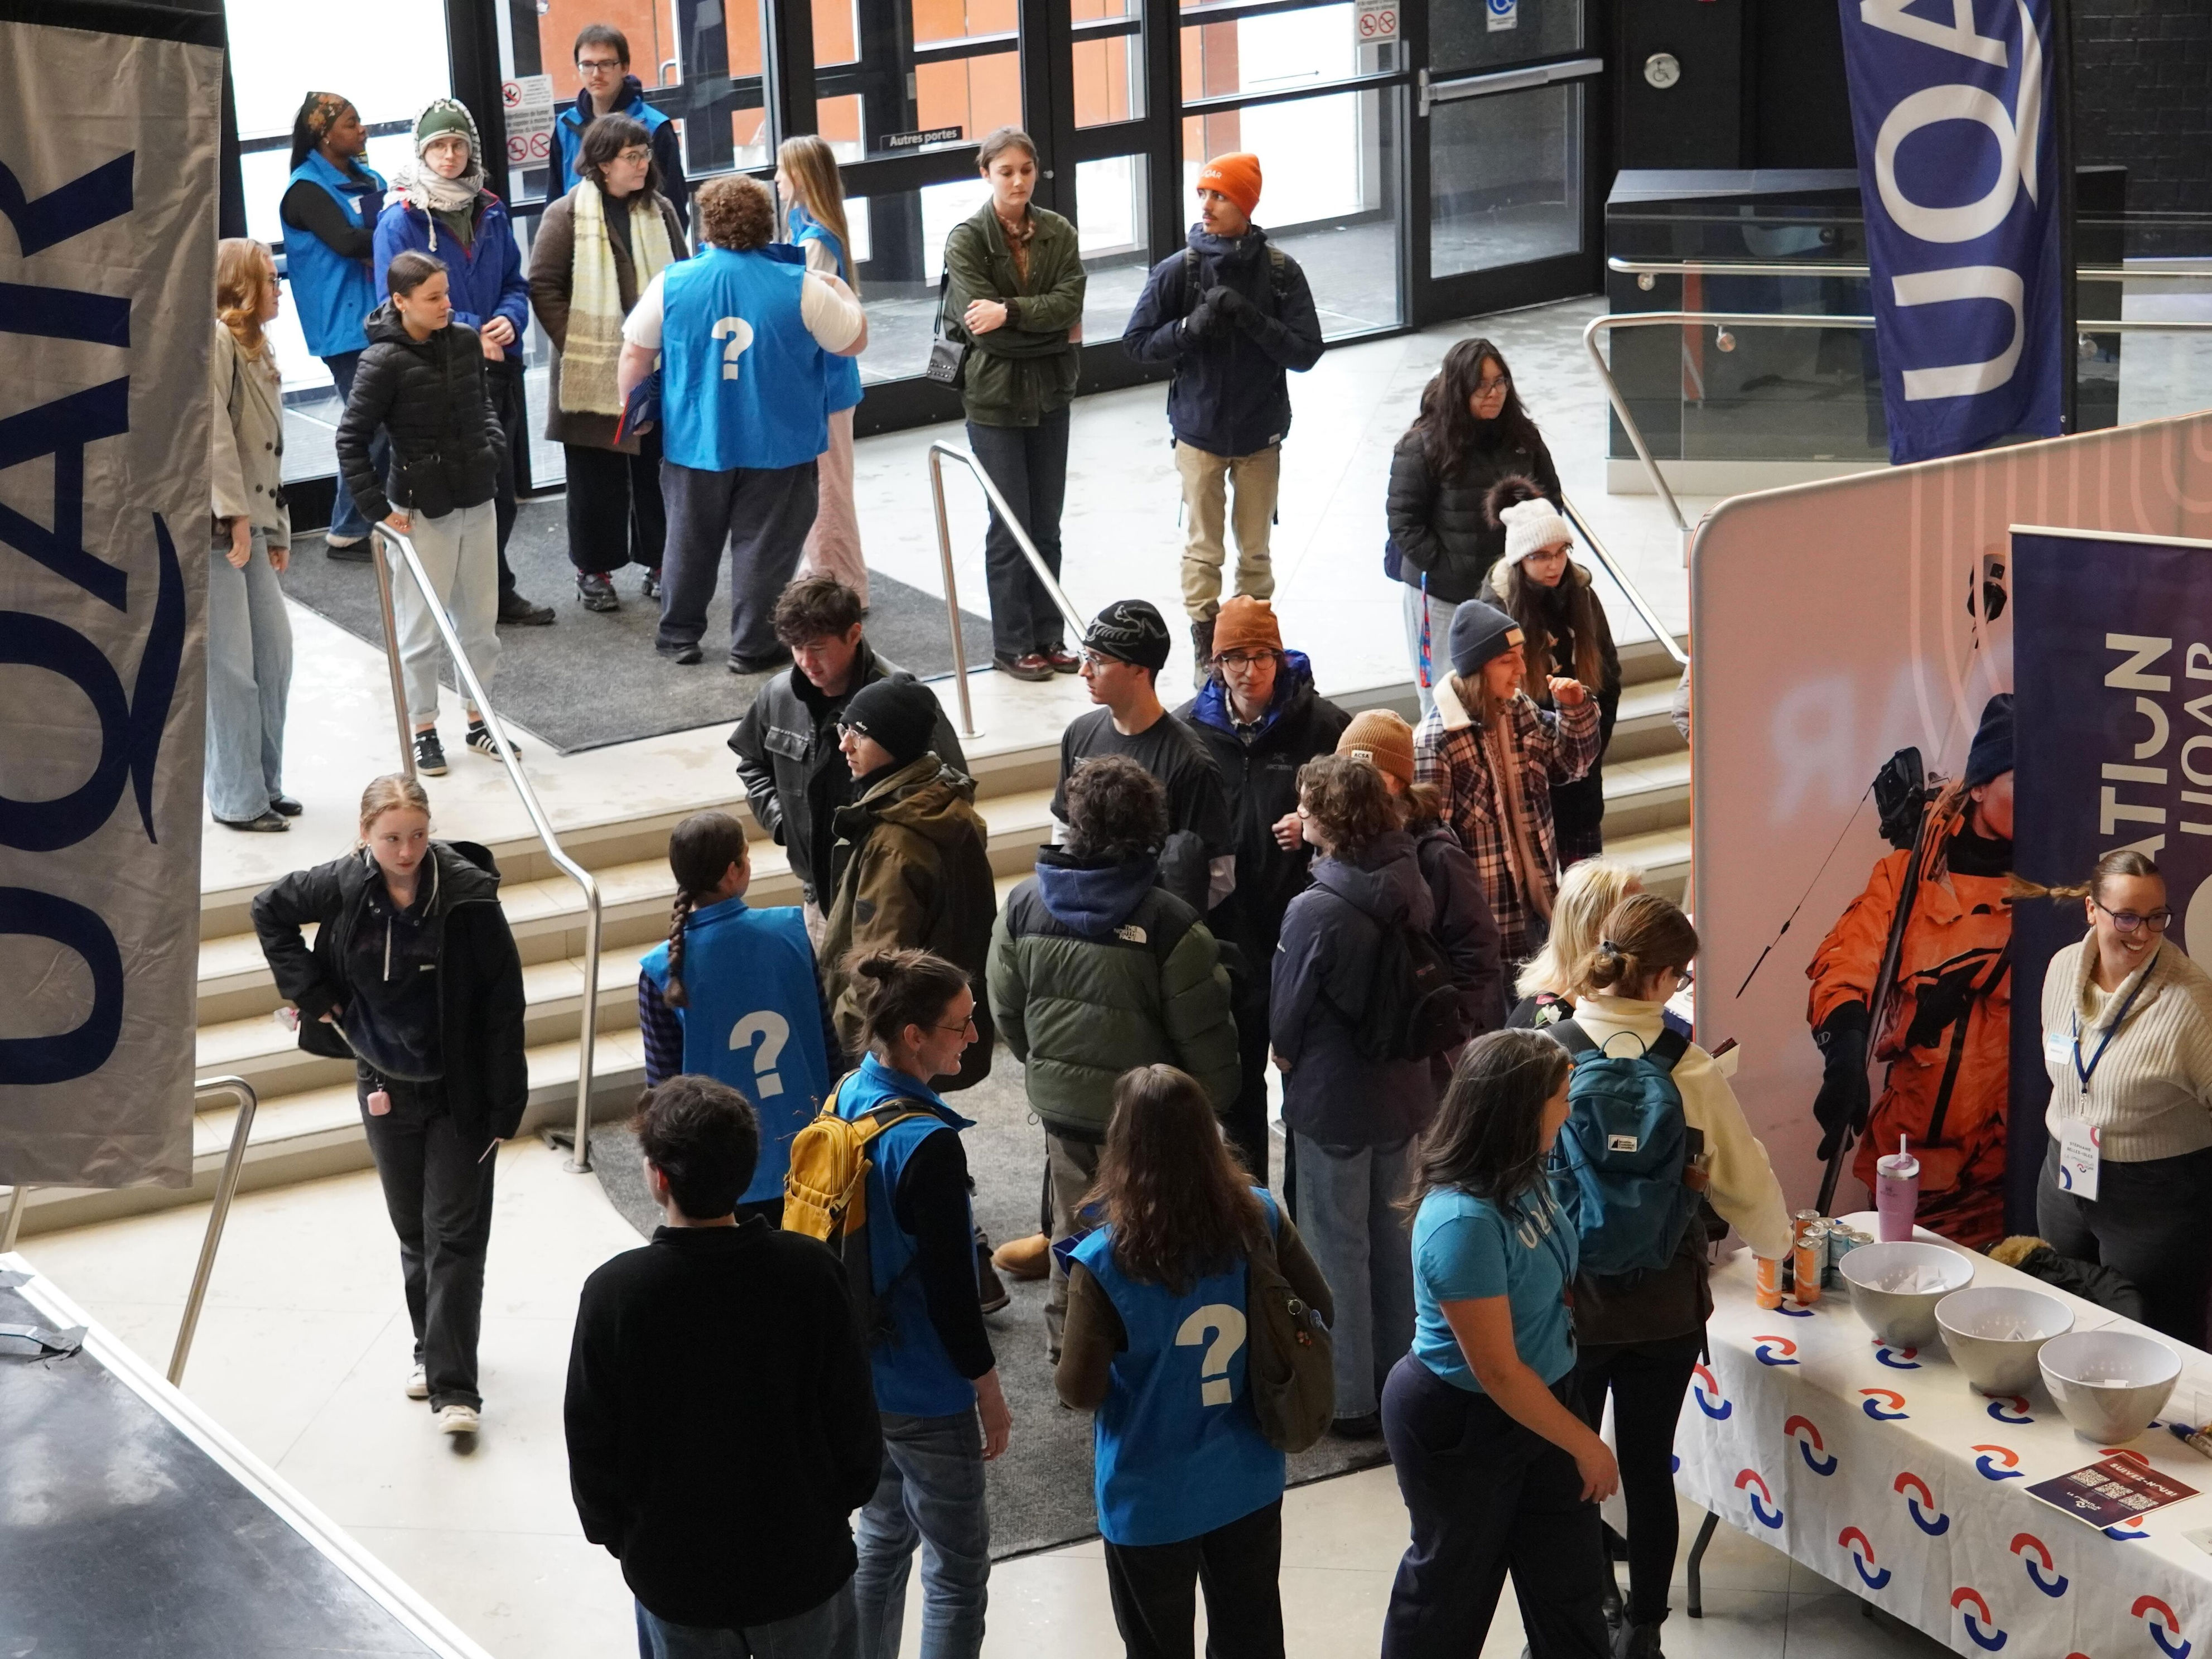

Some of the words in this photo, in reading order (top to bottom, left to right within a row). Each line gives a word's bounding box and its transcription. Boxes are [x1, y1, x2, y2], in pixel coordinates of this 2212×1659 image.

[889, 135, 923, 147] Autres
[923, 129, 957, 144] portes
[711, 317, 754, 381] ?
[729, 1010, 791, 1099] ?
[1175, 1303, 1248, 1407] ?
[2110, 1463, 2177, 1497] SUIVEZ-NOUS!
